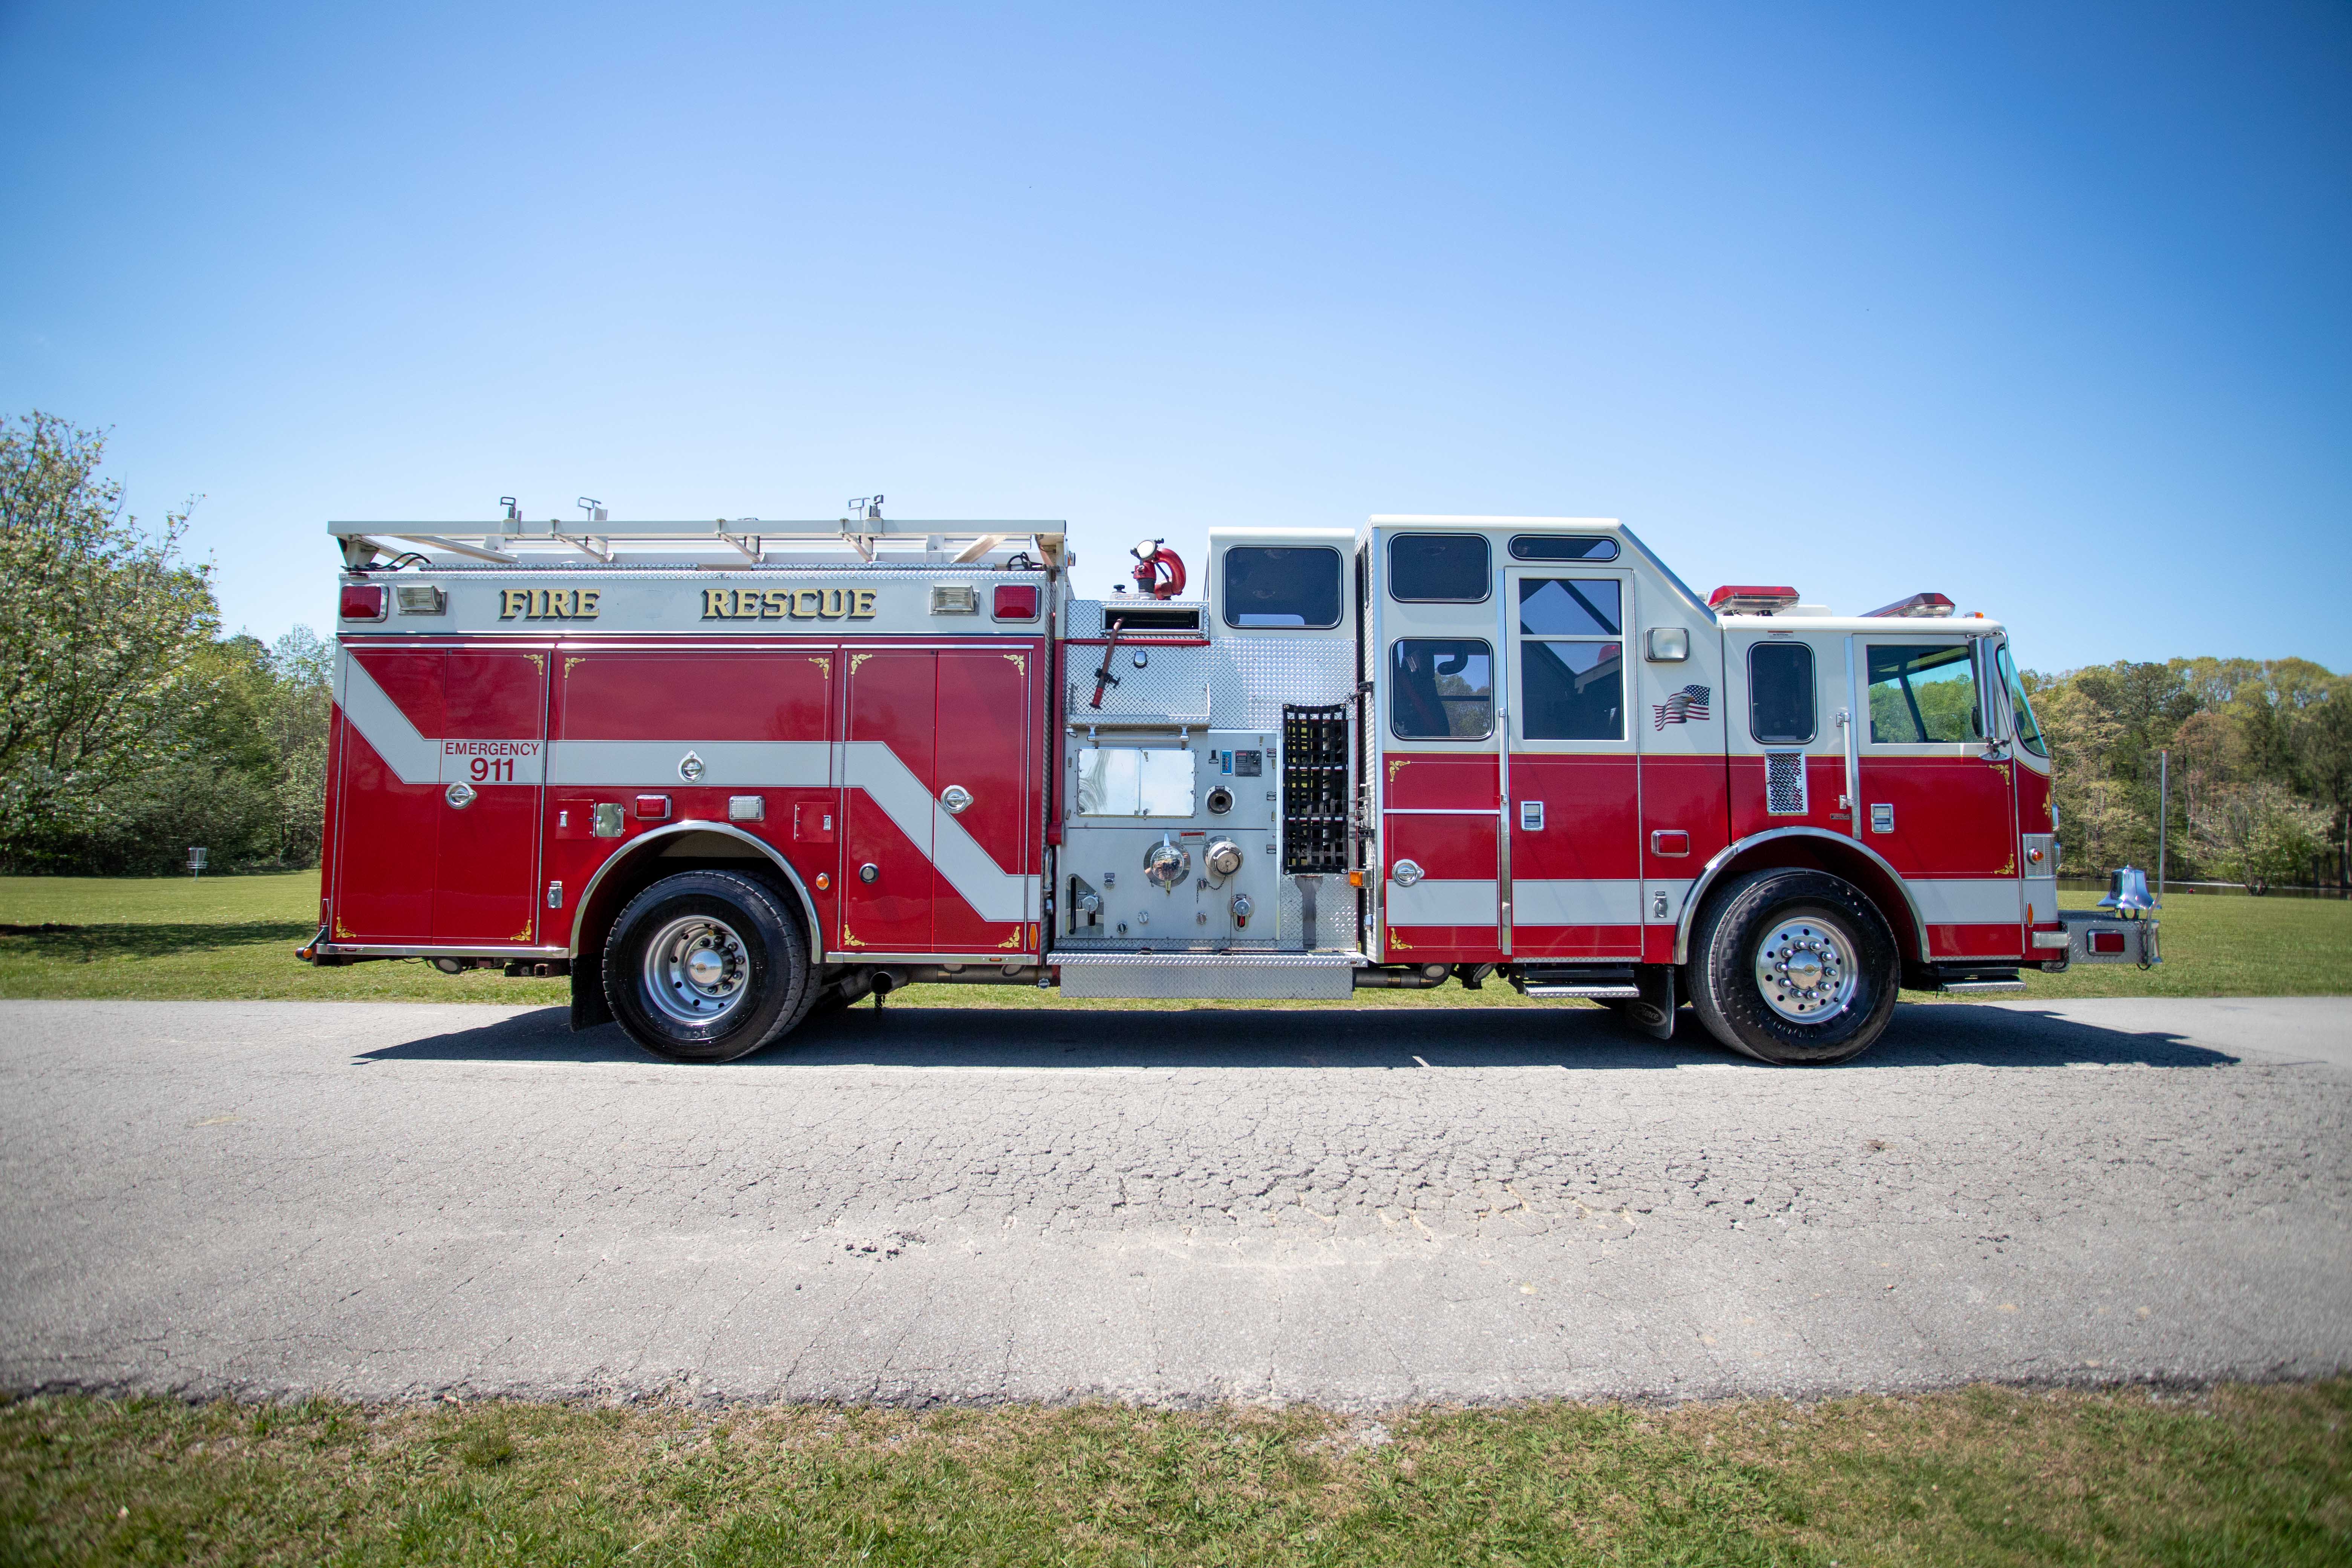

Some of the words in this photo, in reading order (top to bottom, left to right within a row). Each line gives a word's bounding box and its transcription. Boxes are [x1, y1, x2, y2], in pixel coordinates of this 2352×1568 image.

[498, 589, 600, 621] FIRE
[700, 588, 877, 621] RESCUE
[445, 742, 540, 756] EMERGENCY
[470, 757, 514, 782] 911
